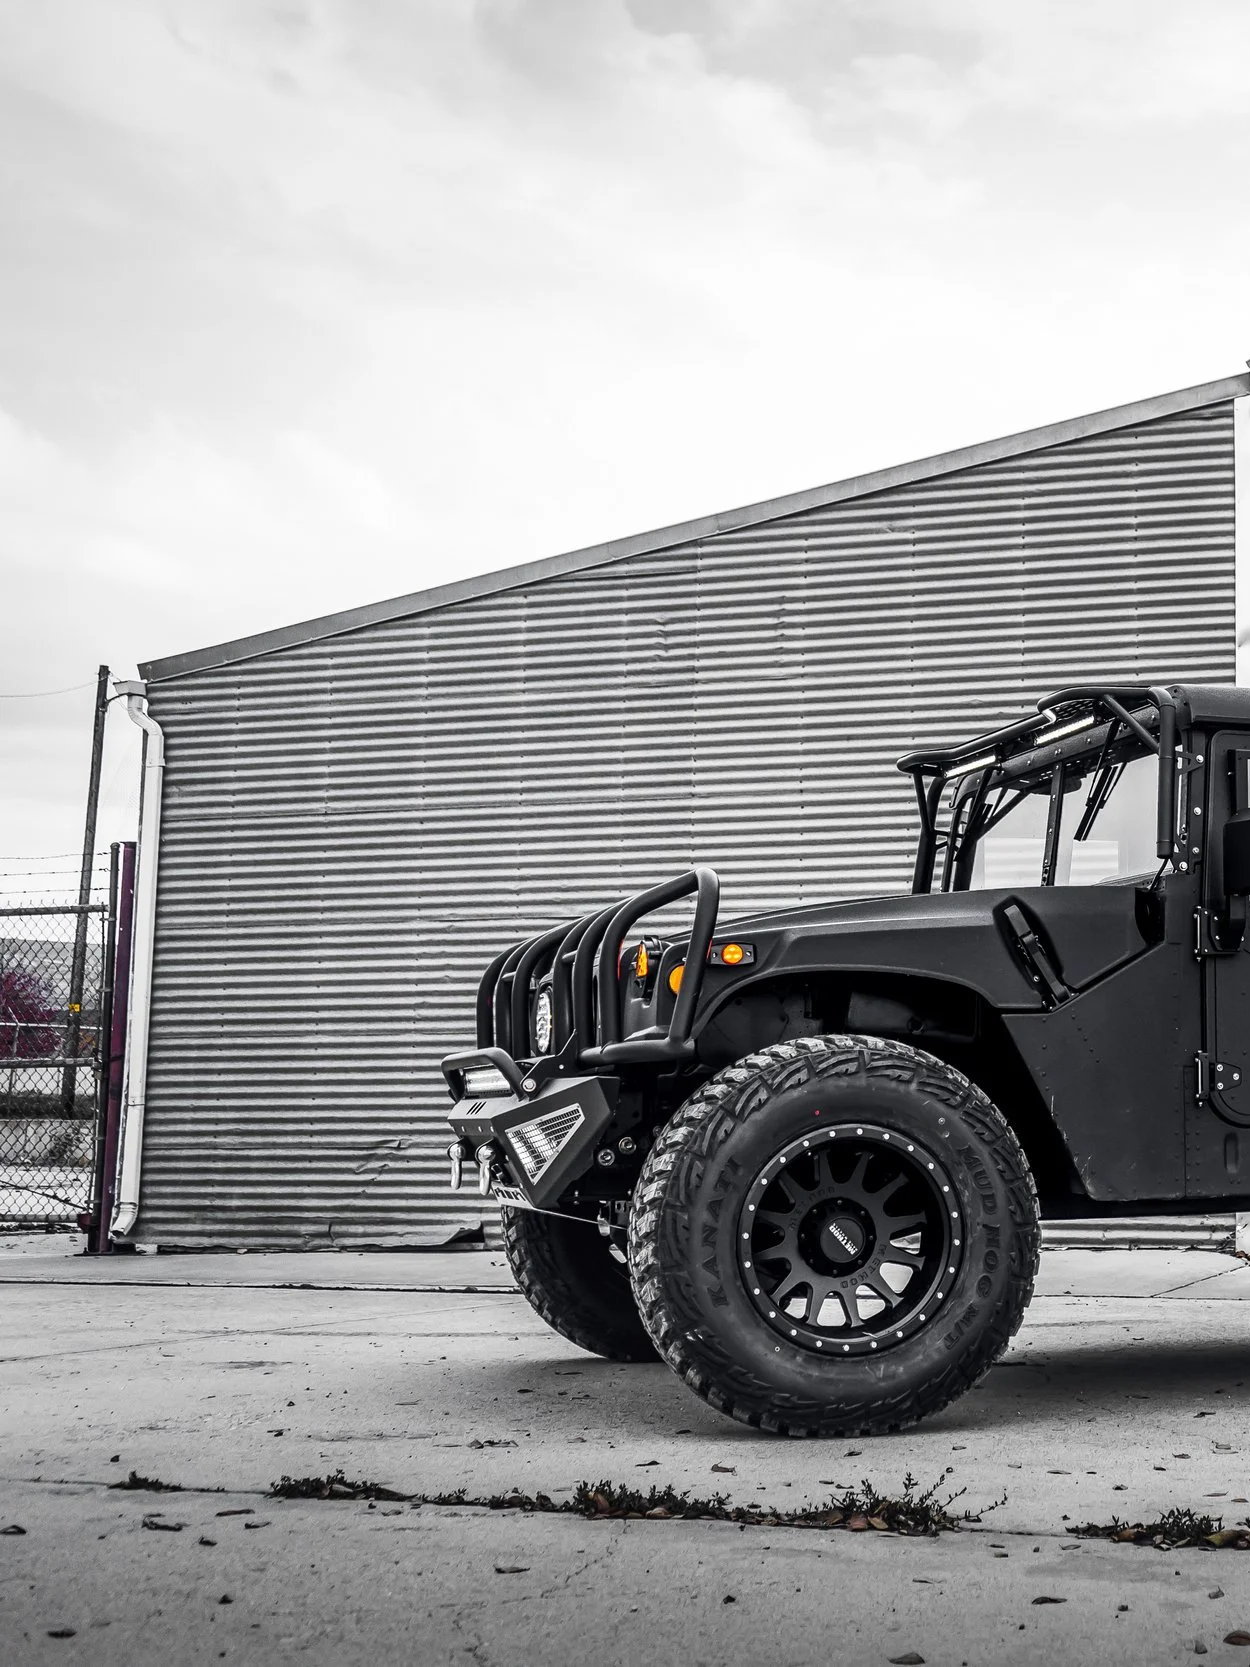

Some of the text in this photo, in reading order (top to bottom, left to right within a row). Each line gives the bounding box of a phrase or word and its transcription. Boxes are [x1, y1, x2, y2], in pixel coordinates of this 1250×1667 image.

[958, 1145, 998, 1215] MUD
[703, 1157, 739, 1308] KANATI
[828, 1224, 858, 1256] METHOD
[976, 1223, 1001, 1298] HOG
